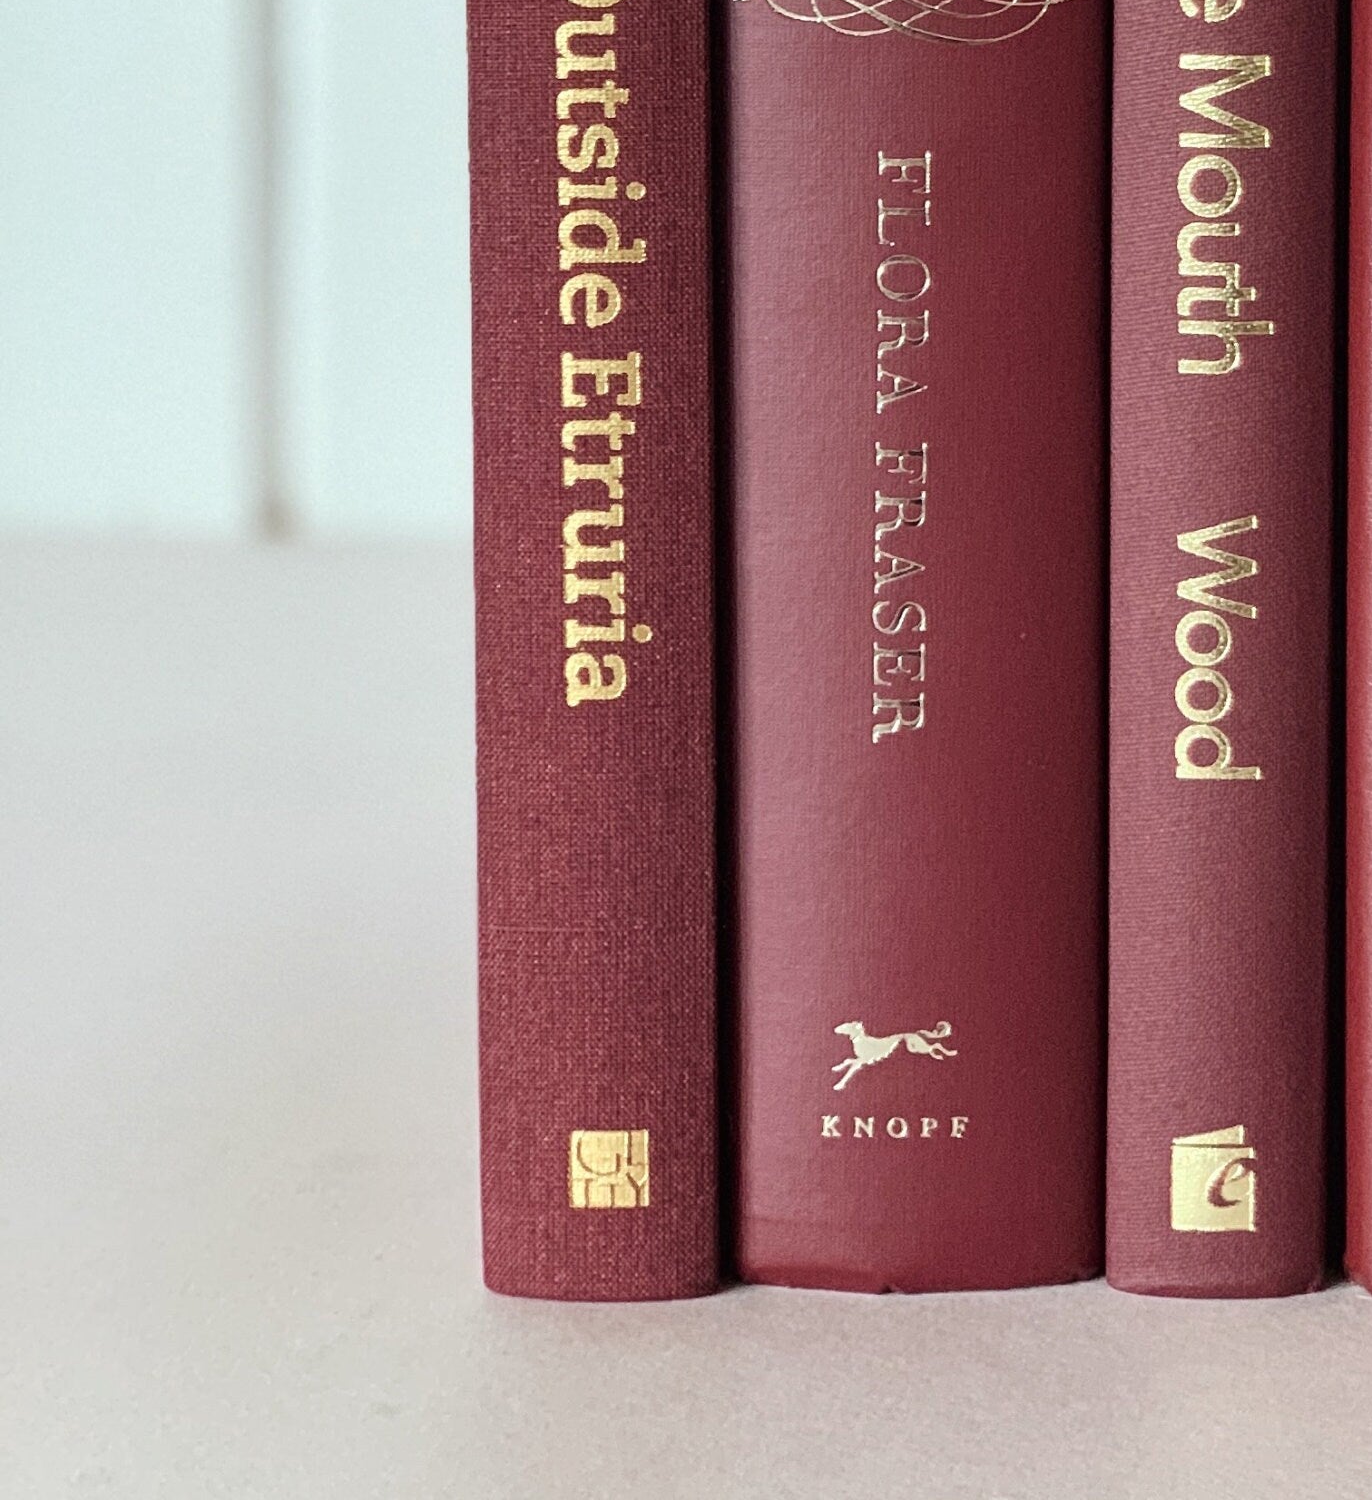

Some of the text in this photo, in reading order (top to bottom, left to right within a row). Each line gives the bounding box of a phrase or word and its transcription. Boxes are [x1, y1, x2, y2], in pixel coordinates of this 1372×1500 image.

[1177, 54, 1274, 375] Mouth
[560, 352, 652, 707] Etruria
[868, 151, 937, 743] FLORA FRASER
[1175, 515, 1263, 782] Wood
[821, 1115, 971, 1139] KNOPF
